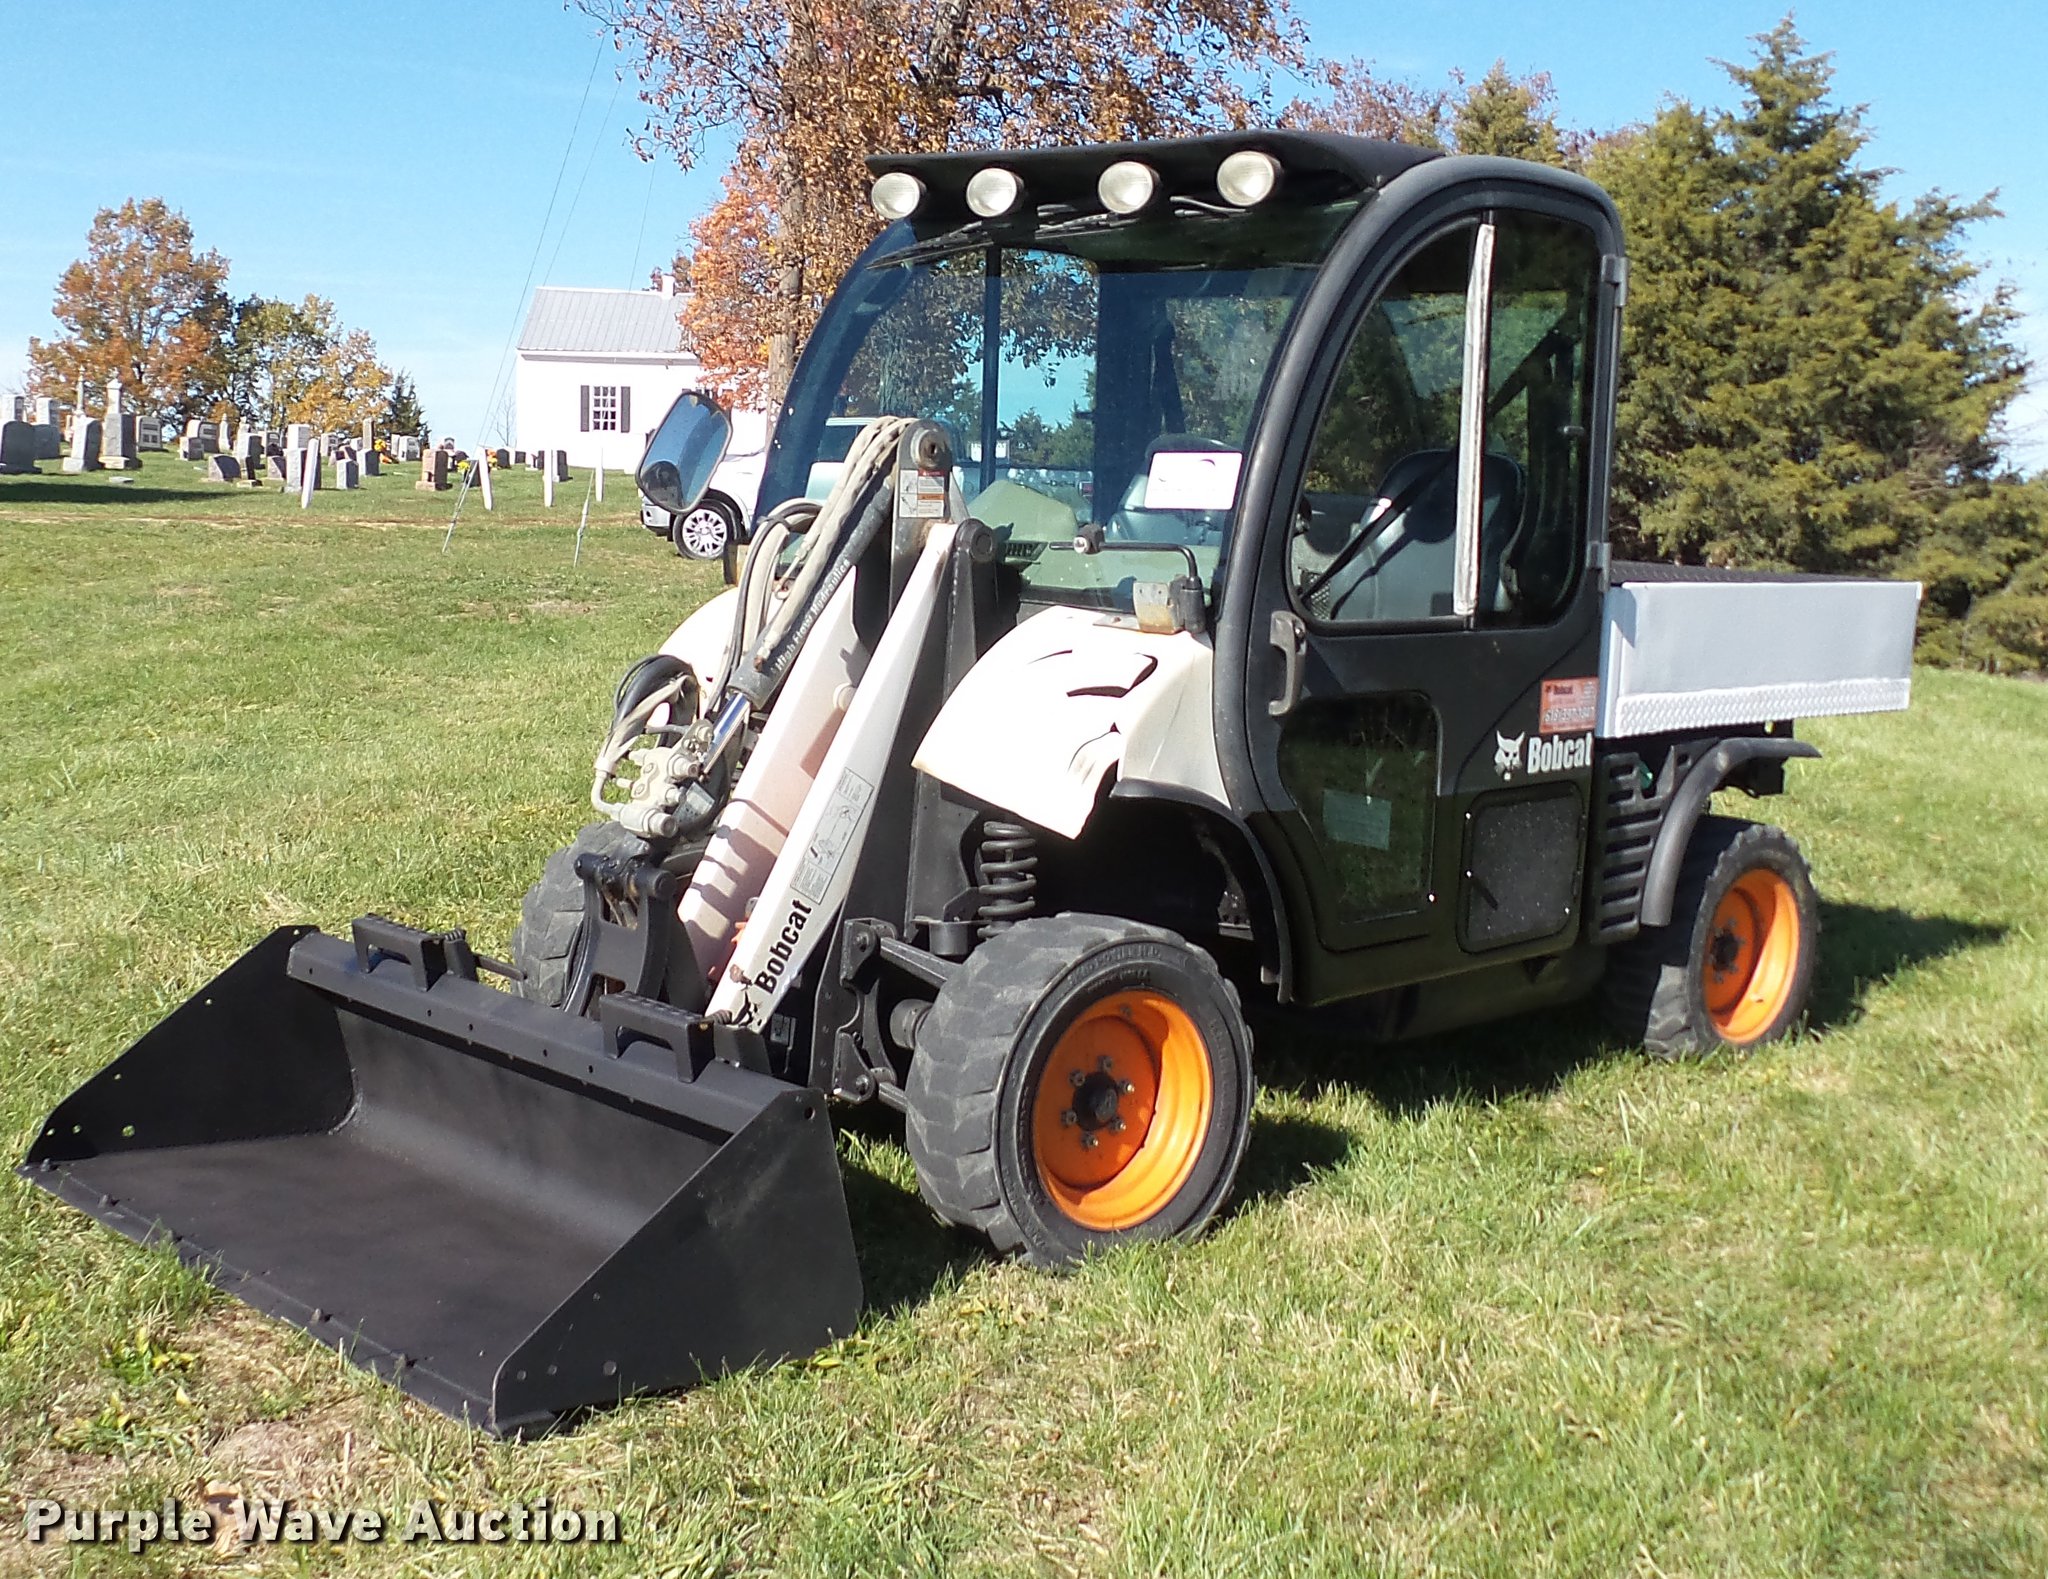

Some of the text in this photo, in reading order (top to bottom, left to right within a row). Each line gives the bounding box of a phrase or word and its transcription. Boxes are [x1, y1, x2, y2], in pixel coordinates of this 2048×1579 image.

[774, 643, 797, 672] High
[810, 557, 851, 616] Hydraulics
[1527, 731, 1593, 775] Bobcat
[753, 899, 812, 994] Bobcat
